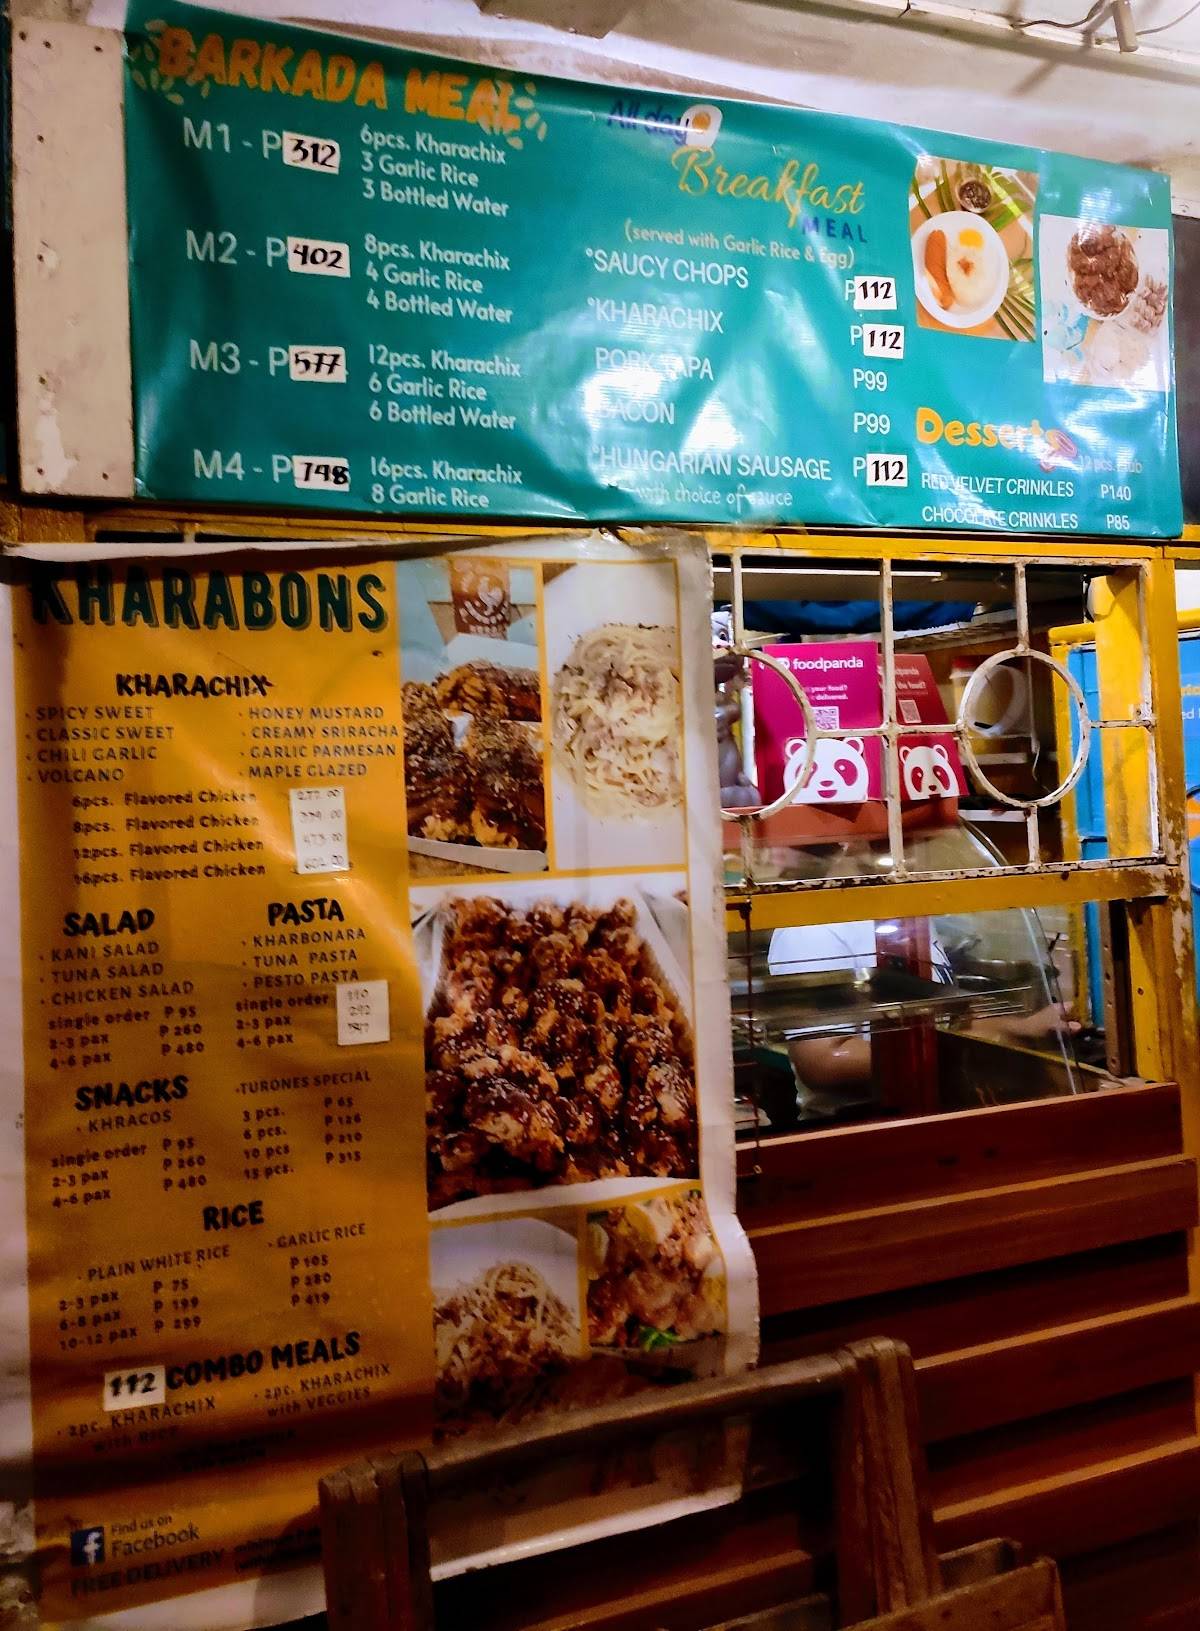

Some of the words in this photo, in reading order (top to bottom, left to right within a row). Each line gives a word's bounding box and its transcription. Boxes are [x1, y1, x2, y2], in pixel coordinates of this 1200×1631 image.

[157, 27, 387, 110] BARKADA
[405, 68, 522, 130] MEAL
[183, 117, 231, 153] M1
[361, 124, 409, 152] 6pcs.
[416, 133, 506, 165] Kharachix
[362, 154, 374, 172] 3
[379, 156, 436, 183] Garlic
[441, 165, 479, 187] Rice
[671, 145, 865, 228] Breakfast
[363, 181, 375, 198] 3
[381, 181, 449, 209] Bottled
[453, 192, 509, 218] Water
[625, 218, 684, 245] (served
[689, 228, 719, 249] with
[723, 235, 766, 256] Garlic
[770, 242, 800, 260] Rice
[803, 249, 813, 260] &
[802, 215, 868, 243] MEAL
[186, 229, 238, 265] M2
[364, 233, 415, 261] 8pcs.
[419, 240, 511, 271] Kharachix
[365, 266, 378, 281] 4
[383, 267, 440, 291] Garlic
[445, 273, 483, 293] Rice
[673, 261, 749, 289] CHOPS
[367, 293, 379, 309] 4
[385, 291, 453, 317] Bottled
[458, 299, 513, 324] Water
[189, 339, 240, 375] M3
[369, 344, 425, 371] 12pcs.
[431, 350, 522, 377] Kharachix
[595, 347, 654, 372] PORK
[369, 375, 381, 392] 6
[387, 375, 444, 399] Garlic
[449, 379, 487, 401] Rice
[853, 368, 887, 391] P99
[370, 403, 381, 421] 6
[387, 403, 455, 427] Bottled
[460, 406, 516, 430] Water
[853, 413, 890, 435] P99
[194, 449, 243, 480] M4
[371, 456, 427, 481] 16pcs.
[431, 459, 522, 485] Kharachix
[737, 455, 832, 481] SAUSAGE
[921, 473, 948, 489] RED
[951, 477, 1004, 494] VELVET
[1007, 478, 1074, 497] CRINKLES
[1101, 484, 1131, 501] P140
[372, 488, 384, 504] 8
[390, 487, 446, 507] Garlic
[451, 490, 489, 509] Rice
[675, 482, 721, 504] choice
[726, 483, 746, 514] of
[1009, 511, 1078, 529] CRINKLES
[1106, 514, 1130, 530] P85
[30, 571, 388, 632] KHARABONS
[793, 656, 863, 671] foodpanda
[116, 672, 272, 698] KHARACHIX
[36, 707, 88, 720] SPICY
[94, 706, 153, 719] SWEET
[249, 707, 305, 719] HONEY
[310, 706, 383, 718] MUSTARD
[37, 727, 110, 742] CLASSIC
[116, 726, 174, 739] SWEET
[252, 726, 316, 739] CREAMY
[321, 725, 398, 738] SRIRACHA
[37, 749, 87, 762] CHILI
[93, 746, 158, 760] GARLIC
[250, 746, 307, 758] GARLIC
[313, 744, 396, 757] PARMESAN
[38, 768, 125, 783] VOLCANO
[249, 765, 301, 778] MAPLE
[307, 764, 368, 776] GLAZED
[125, 791, 193, 806] Flavored
[126, 816, 194, 831] Flavored
[130, 841, 198, 856] Flavored
[203, 839, 263, 853] Chicken
[130, 866, 198, 881] Flavored
[203, 863, 265, 877] Chicken
[63, 908, 155, 937] SALAD
[268, 898, 344, 926] PASTA
[254, 928, 367, 947] KHARBONARA
[52, 946, 96, 961] KANI
[103, 942, 159, 958] SALAD
[254, 953, 298, 968] TUNA
[309, 949, 358, 964] PASTA
[52, 968, 100, 983] TUNA
[108, 963, 164, 978] SALAD
[254, 974, 305, 988] PESTO
[311, 969, 359, 984] PASTA
[52, 986, 132, 1005] CHICKEN
[138, 981, 194, 998] SALAD
[236, 998, 282, 1012] single
[288, 993, 328, 1008] order
[49, 1014, 99, 1030] single
[105, 1009, 150, 1024] order
[164, 1006, 174, 1018] P
[179, 1006, 197, 1018] 95
[75, 1075, 188, 1111] SNACKS
[240, 1076, 309, 1094] TURONES
[314, 1071, 370, 1087] SPECIAL
[88, 1110, 172, 1132] KHRACOS
[203, 1201, 264, 1231] RICE
[277, 1229, 330, 1248] GARLIC
[334, 1223, 366, 1239] RICE
[87, 1262, 135, 1281] PLAIN
[140, 1251, 191, 1272] WHITE
[196, 1244, 230, 1262] RICE
[291, 1256, 299, 1269] P
[166, 1351, 263, 1391] COMBO
[271, 1331, 360, 1370] MEALS
[108, 1372, 156, 1398] 112
[299, 1364, 391, 1392] KHARACHIX
[307, 1387, 371, 1411] VEGGIES
[111, 1396, 216, 1429] KHARACHIX
[157, 1515, 172, 1526] on
[112, 1521, 199, 1558] Facebook
